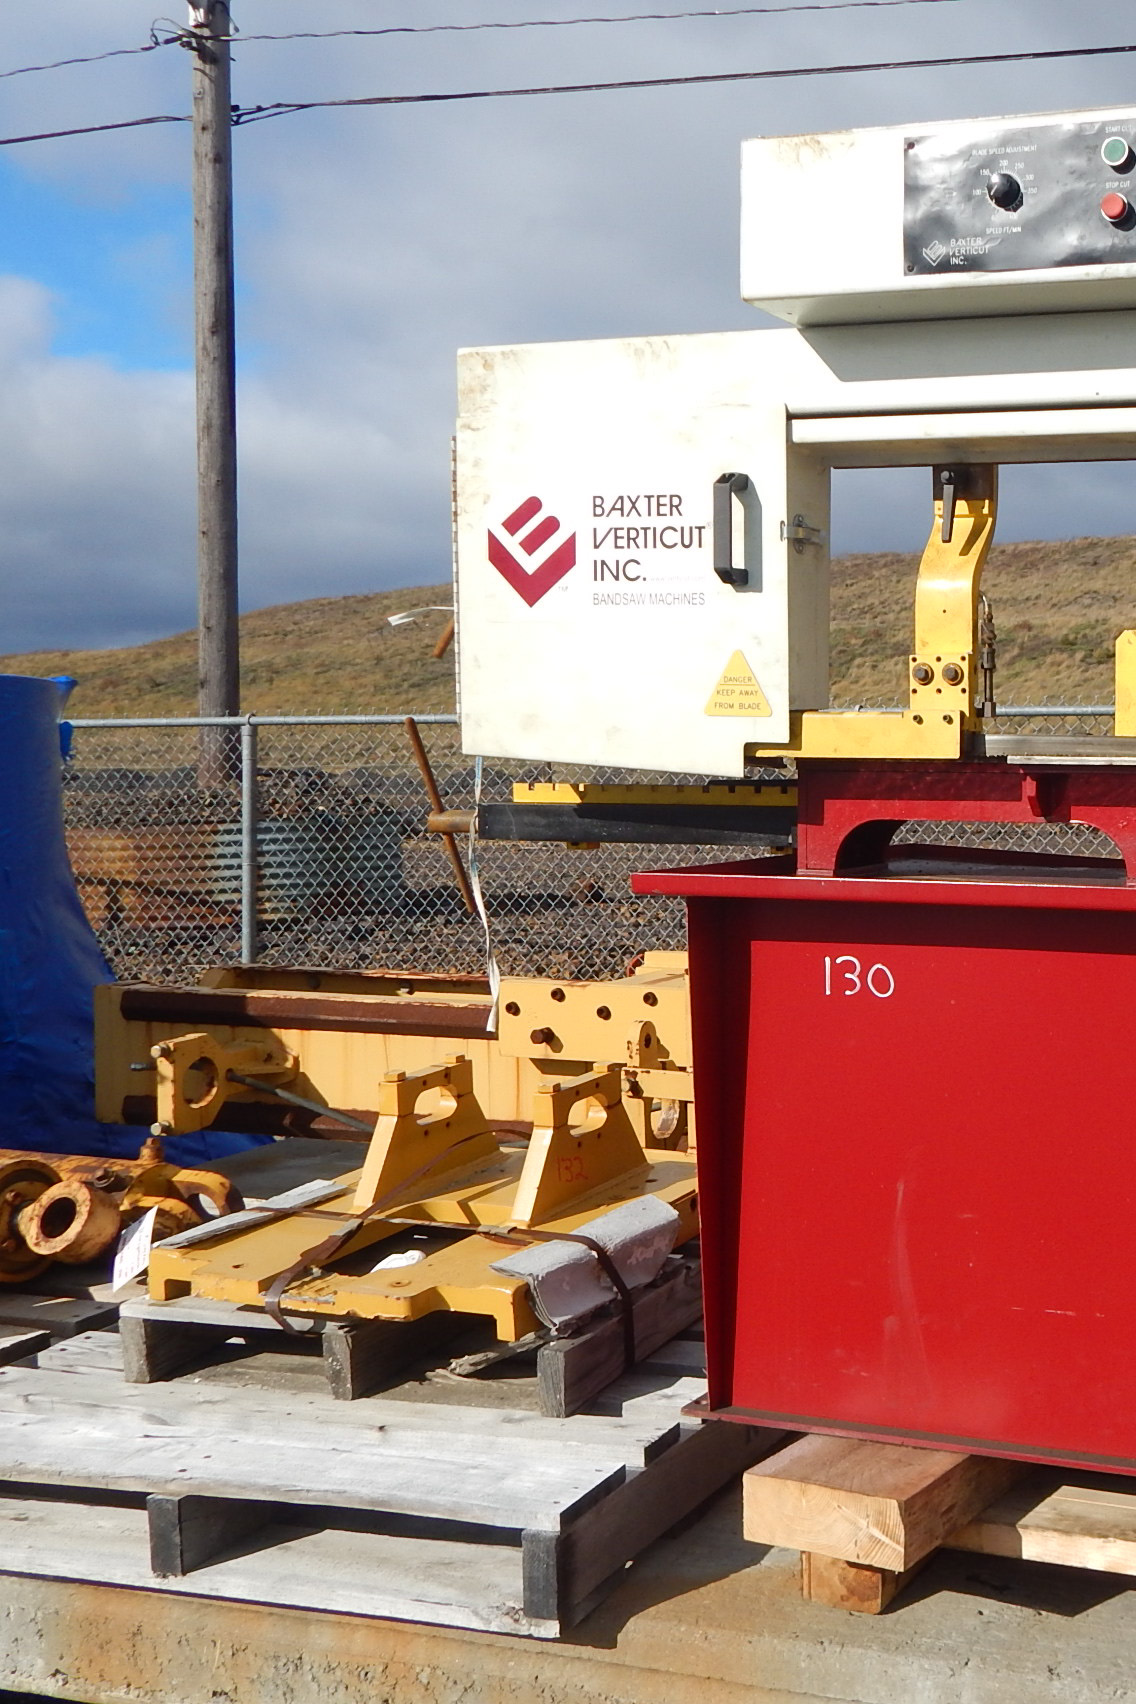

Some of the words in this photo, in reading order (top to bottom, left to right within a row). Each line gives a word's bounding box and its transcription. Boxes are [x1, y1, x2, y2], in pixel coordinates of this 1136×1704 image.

[1105, 125, 1121, 133] START
[1105, 181, 1120, 189] STOP
[1120, 180, 1131, 188] CUT
[950, 237, 982, 247] BAXTER
[949, 245, 990, 256] VERTICUT
[950, 256, 968, 265] INC.
[592, 494, 683, 518] BAXTER
[592, 525, 706, 550] VERTICUT
[592, 558, 647, 582] INC.
[592, 592, 646, 605] BANDSAW
[649, 592, 706, 605] MACHINES
[723, 675, 753, 683] DANGER
[716, 689, 736, 697] KEEP
[738, 689, 759, 697] AWAY
[714, 702, 735, 710] FROM
[738, 702, 762, 710] BLADE
[824, 955, 895, 998] 130
